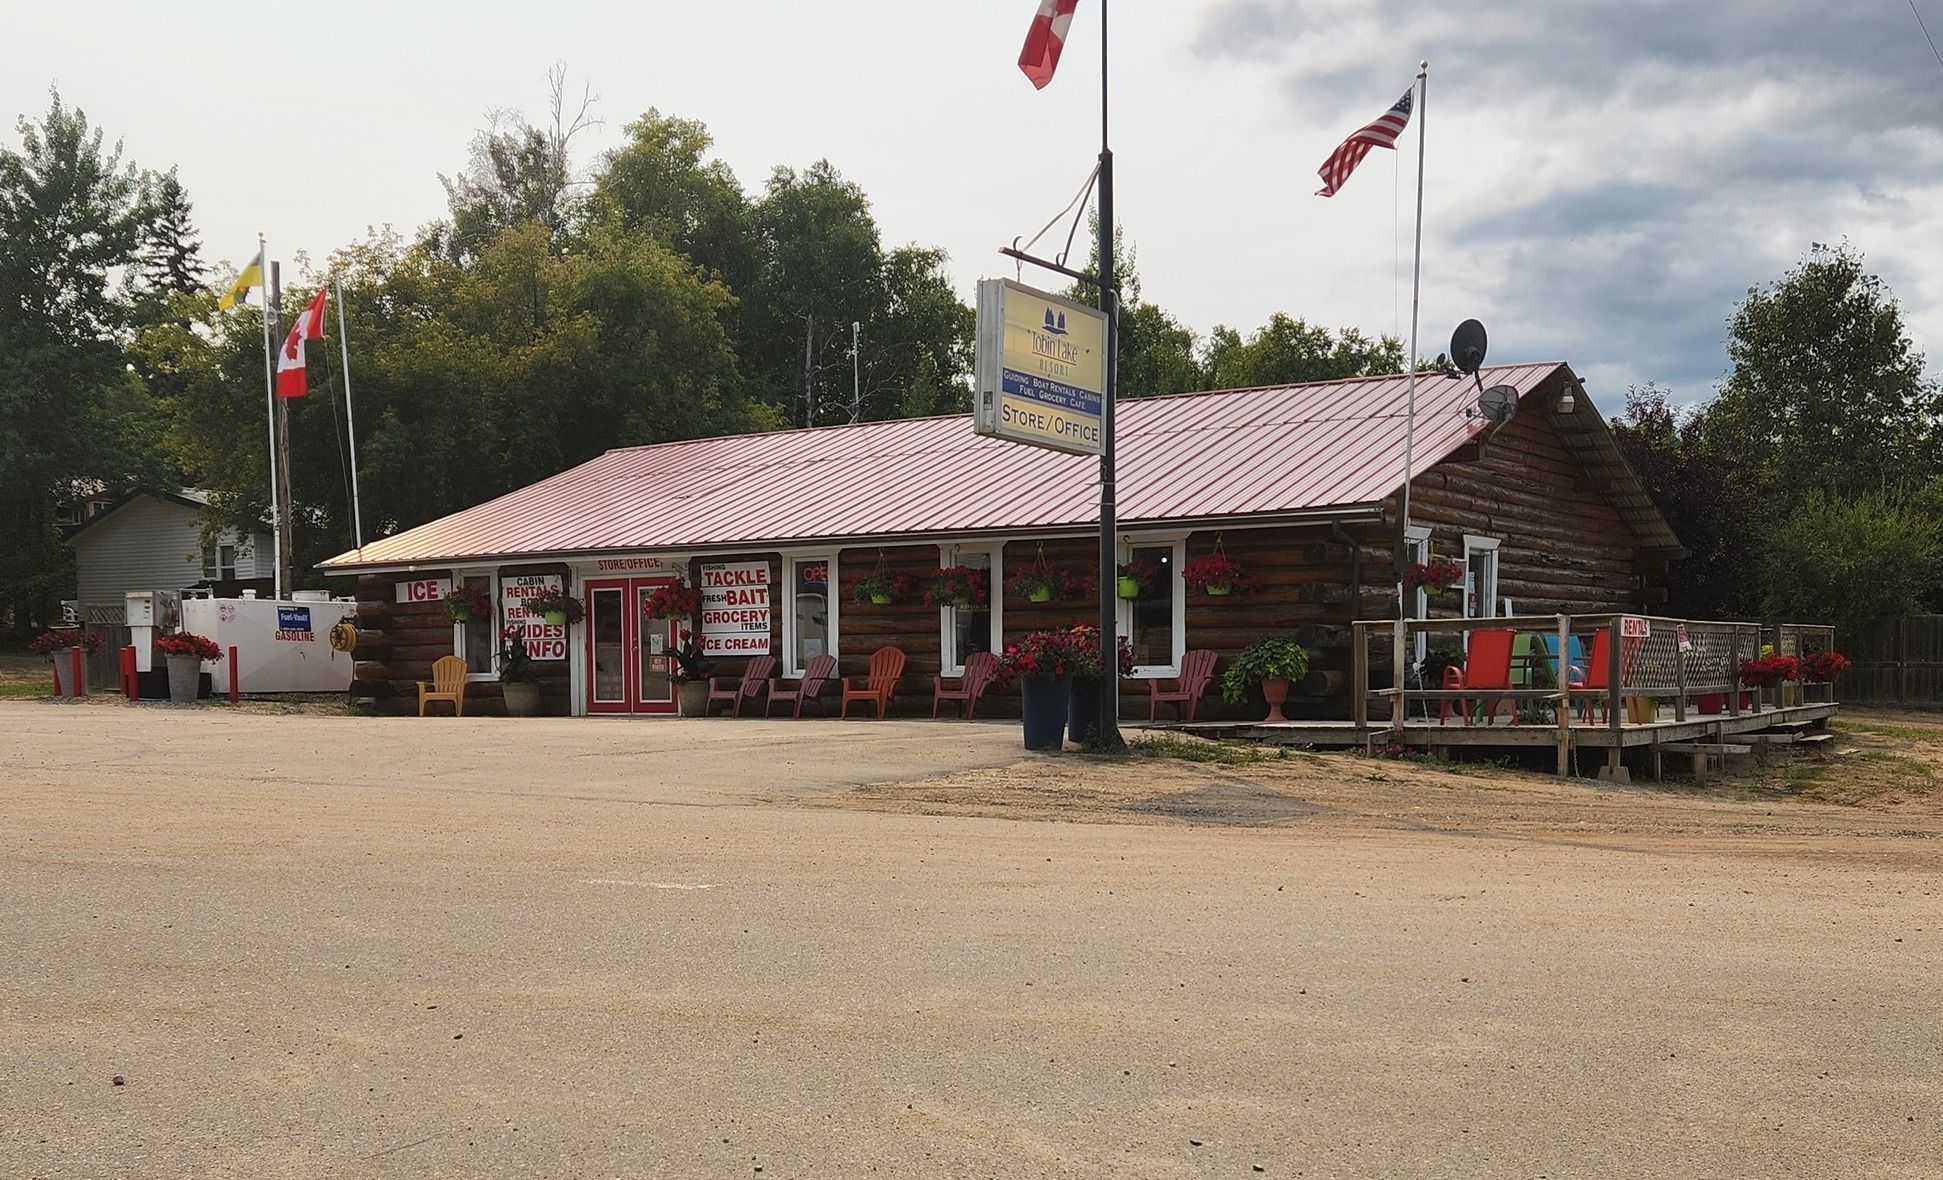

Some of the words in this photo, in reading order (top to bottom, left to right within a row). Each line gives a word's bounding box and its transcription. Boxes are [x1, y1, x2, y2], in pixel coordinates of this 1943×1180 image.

[1032, 331, 1055, 357] Tobin
[1057, 338, 1078, 362] Lake
[1040, 358, 1068, 377] RESORT
[1004, 370, 1029, 385] GUIDING
[1033, 378, 1049, 390] BOAT
[1050, 382, 1076, 397] RENTALS
[1019, 384, 1035, 397] FUEL
[1039, 390, 1067, 405] GROCERY
[1070, 398, 1085, 409] CAFE
[1002, 404, 1098, 441] STORE/OFFICE
[597, 557, 660, 571] STORE/OFFICE
[517, 576, 545, 587] CABIN
[704, 569, 767, 586] TACKLE
[407, 580, 439, 601] ICE
[702, 594, 726, 603] FRESH
[726, 588, 767, 606] BAIT
[704, 609, 768, 624] GROCERY
[741, 622, 768, 631] ITEMS
[275, 630, 315, 642] GASOLINE
[724, 637, 768, 650] CREAM
